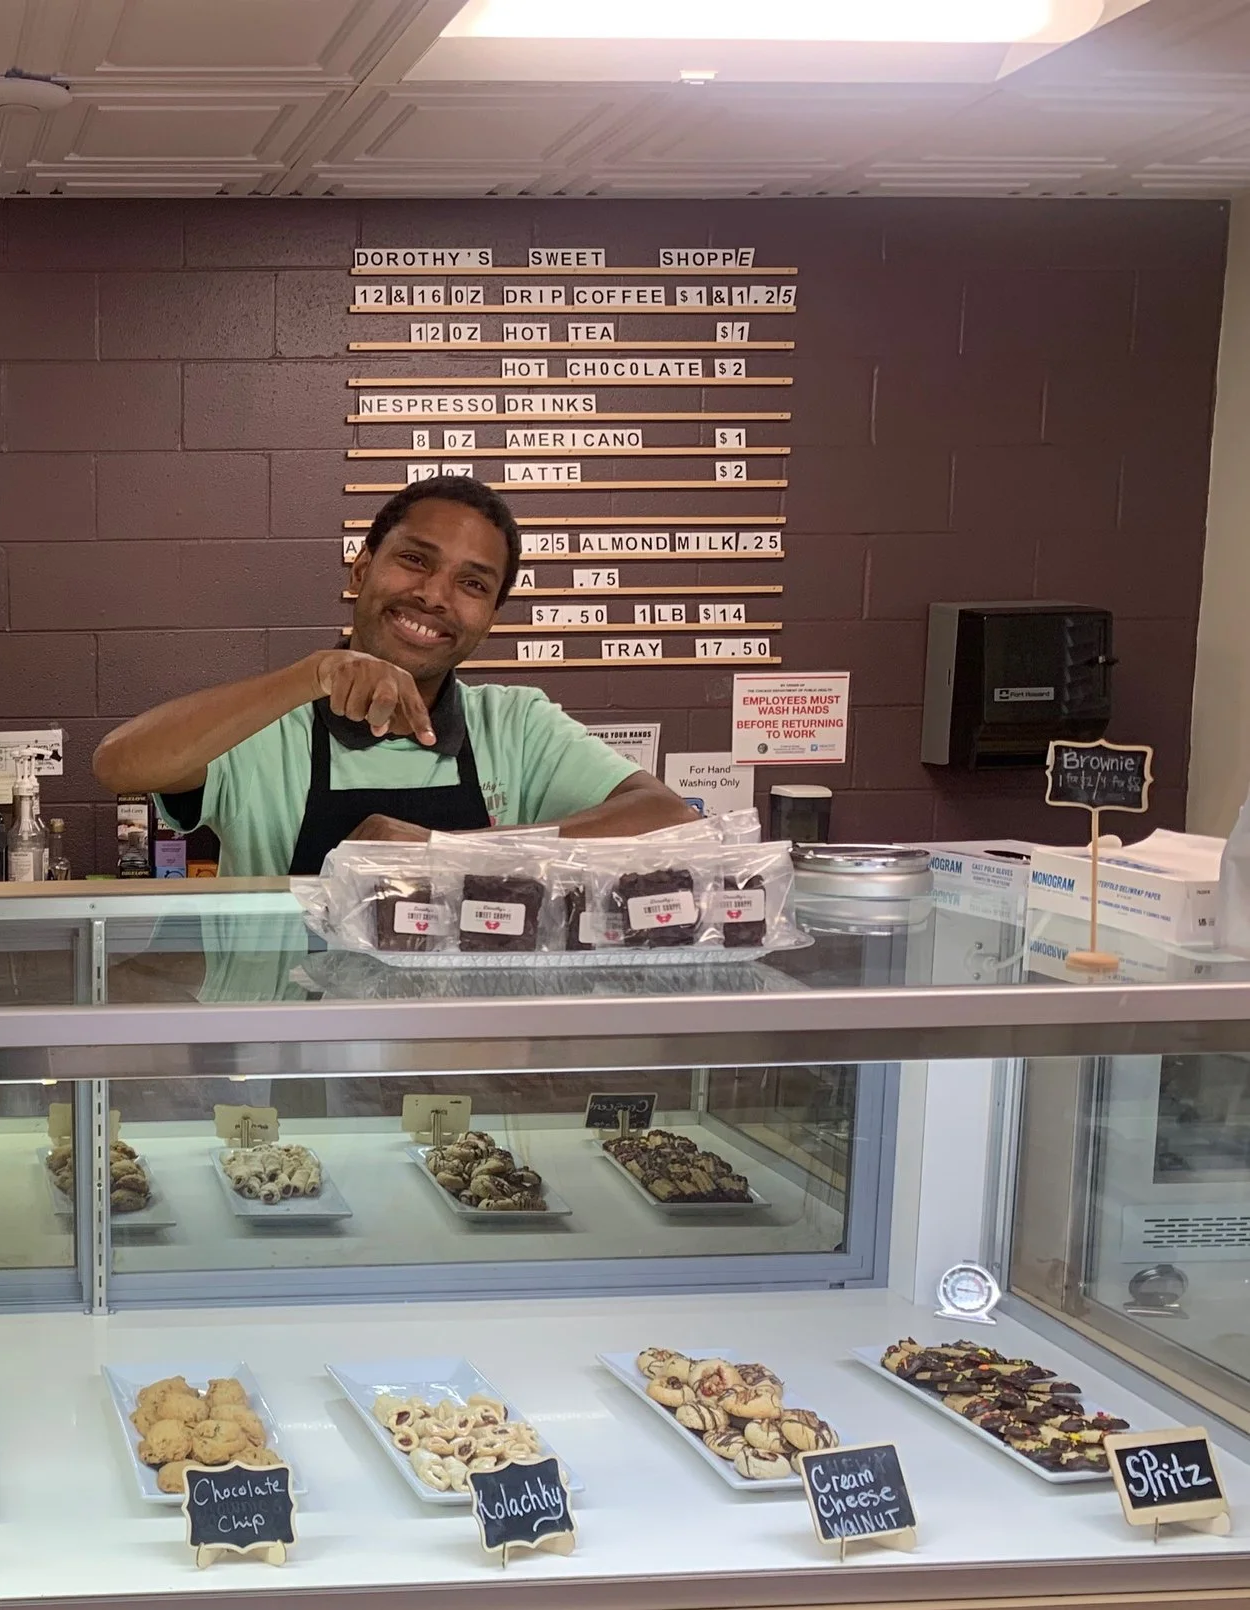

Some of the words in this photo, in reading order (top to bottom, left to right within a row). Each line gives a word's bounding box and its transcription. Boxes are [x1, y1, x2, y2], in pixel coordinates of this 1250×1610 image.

[356, 251, 490, 266] DOROTHY'S
[530, 251, 602, 266] SWEET
[662, 251, 751, 266] SHOPPE
[505, 289, 562, 304] DRIP
[576, 289, 663, 304] COFFEE
[505, 326, 547, 340] HOT
[571, 326, 612, 340] TEA
[720, 325, 745, 341] $1
[504, 362, 546, 376] HOT
[718, 361, 743, 376] $2
[361, 398, 494, 413] NESPRESSO
[507, 398, 594, 412] DRINKS
[416, 434, 426, 447] 8
[509, 433, 640, 447] AMERICANO
[720, 432, 743, 446] $1
[508, 466, 579, 481] LATTE
[719, 464, 743, 479] $2
[582, 536, 668, 551] ALMOND
[678, 536, 733, 550] MILK
[742, 535, 778, 550] .25
[579, 572, 616, 587] .75
[536, 608, 604, 623] $7.50
[703, 607, 743, 621] $14
[523, 644, 561, 658] 1/2
[604, 643, 661, 657] TRAY
[700, 641, 767, 656] 17.50
[742, 696, 807, 706] EMPLOYEES
[810, 695, 841, 705] MUST
[758, 706, 789, 715] WASH
[792, 705, 829, 715] HANDS
[736, 720, 778, 729] BEFORE
[782, 718, 844, 728] RETURNING
[766, 730, 780, 739] TO
[783, 729, 816, 739] WORK
[1063, 751, 1135, 771] Brownie
[689, 766, 705, 774] For
[707, 765, 731, 774] Hand
[679, 778, 717, 789] Washing
[720, 778, 740, 788] Only
[926, 857, 963, 874] NOGRAM
[1031, 870, 1075, 892] MONOGRAM
[810, 1464, 875, 1494] Cream
[193, 1476, 286, 1506] Chocolate
[477, 1476, 563, 1531] Kolachky
[818, 1486, 896, 1518] Cheese
